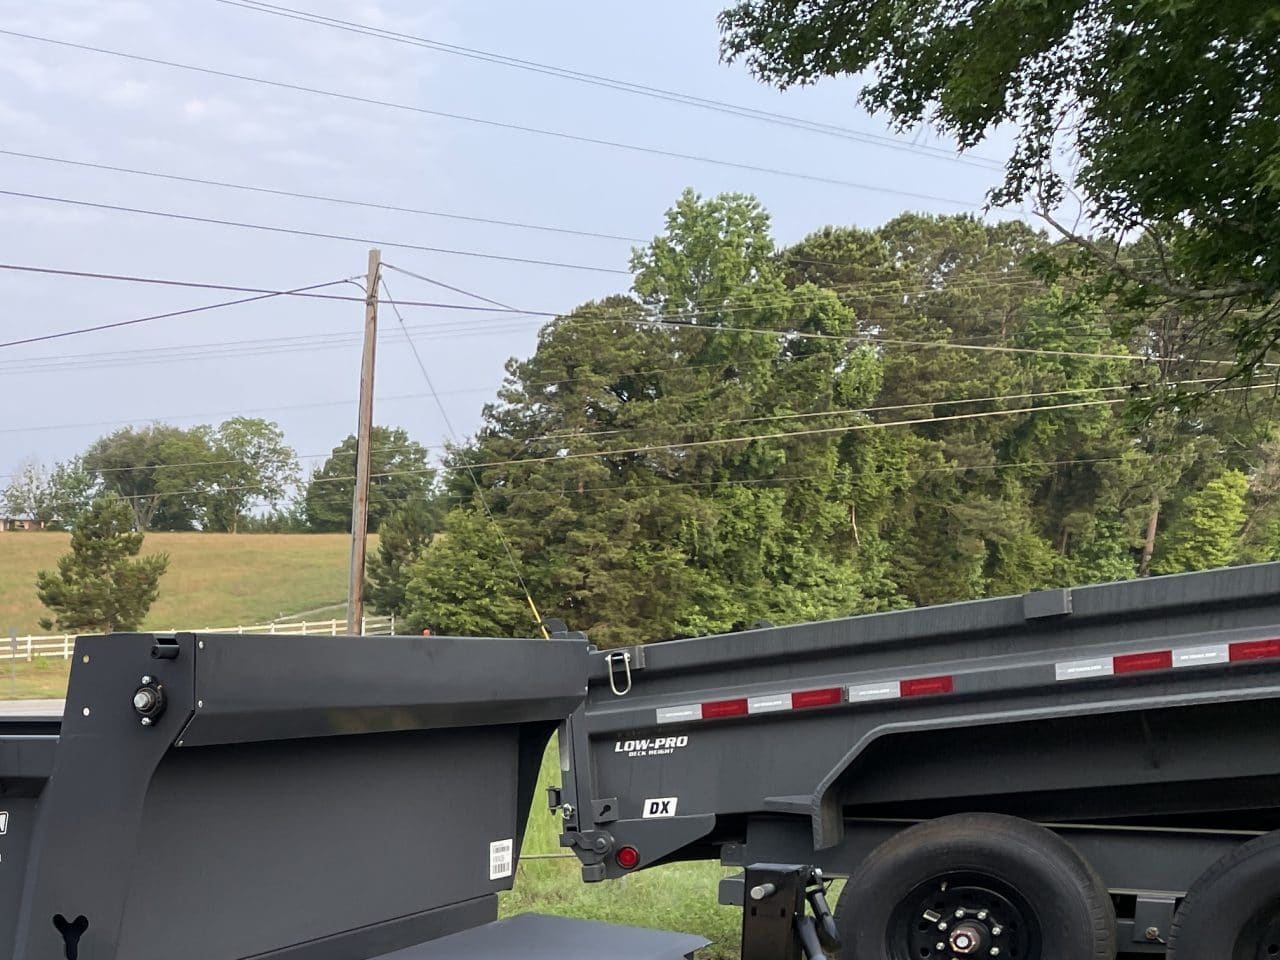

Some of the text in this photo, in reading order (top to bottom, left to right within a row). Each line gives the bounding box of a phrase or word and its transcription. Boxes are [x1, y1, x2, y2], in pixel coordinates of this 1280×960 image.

[614, 735, 689, 753] LOW-PRO
[648, 748, 674, 756] HEIGHT
[649, 801, 671, 815] DX
